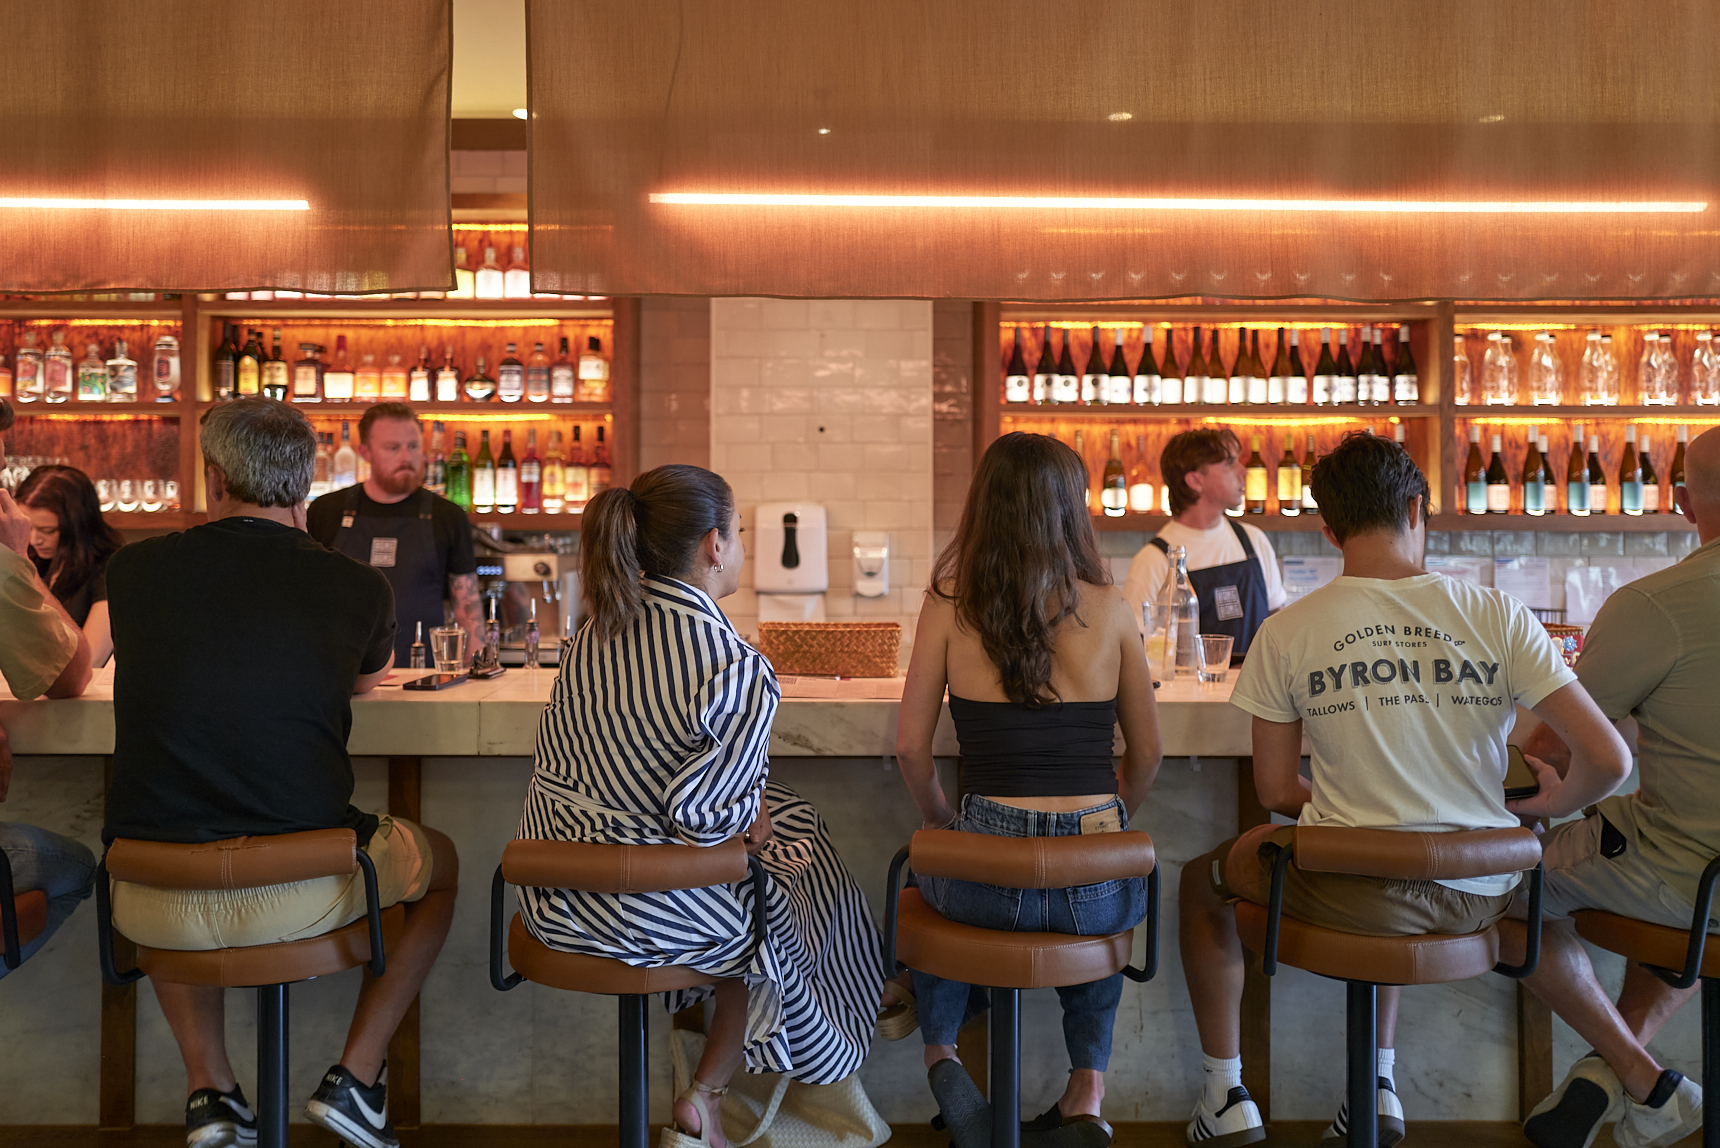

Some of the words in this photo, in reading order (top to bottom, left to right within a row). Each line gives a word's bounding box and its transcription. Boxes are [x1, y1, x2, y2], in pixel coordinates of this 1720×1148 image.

[1333, 624, 1396, 652] GOLDEN
[1403, 626, 1452, 642] BREED
[1308, 658, 1421, 698] BYRON
[1431, 658, 1499, 686] BAY
[1307, 701, 1356, 717] TALLOWS
[1378, 695, 1401, 707] THE
[1451, 695, 1503, 707] WATEGOS
[325, 1073, 343, 1086] NIKE
[190, 1095, 209, 1110] NIKE
